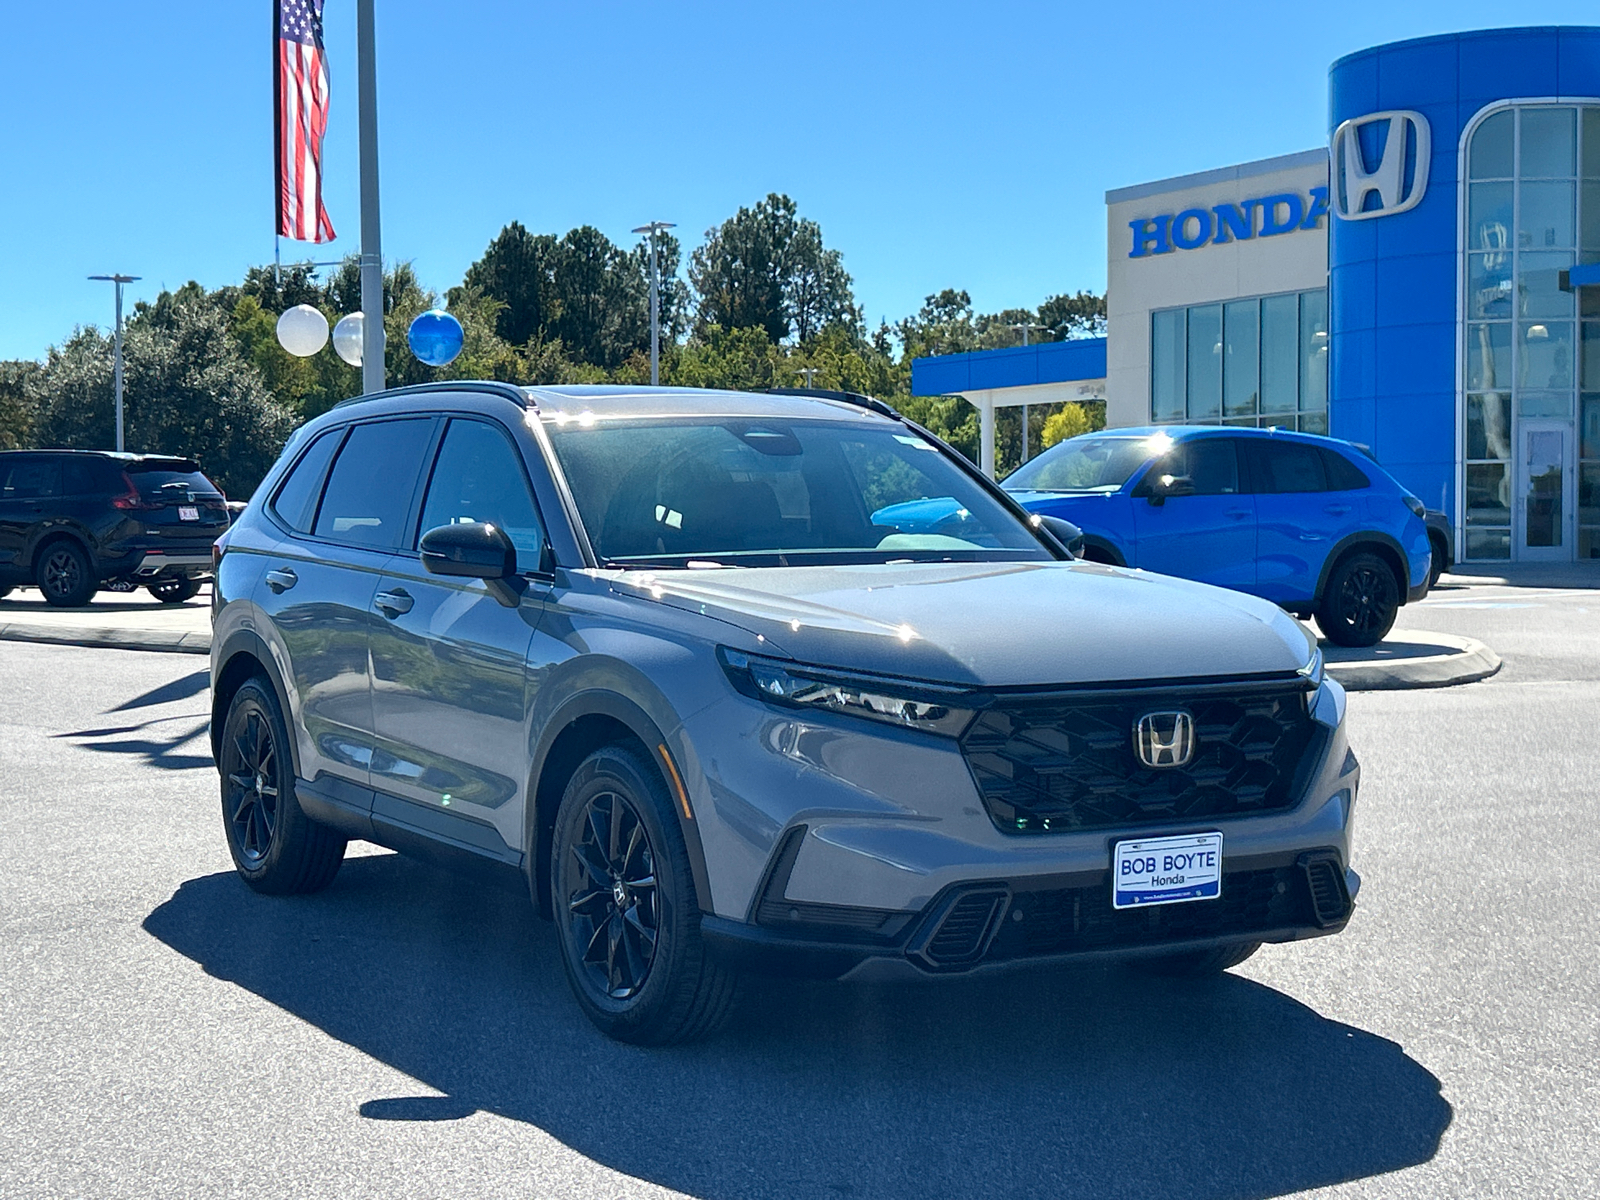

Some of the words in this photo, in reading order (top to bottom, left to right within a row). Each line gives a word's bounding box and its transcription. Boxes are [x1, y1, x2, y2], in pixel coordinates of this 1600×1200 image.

[1121, 857, 1156, 876] BOB
[1163, 851, 1216, 872] BOYTE
[1151, 873, 1185, 887] Honda
